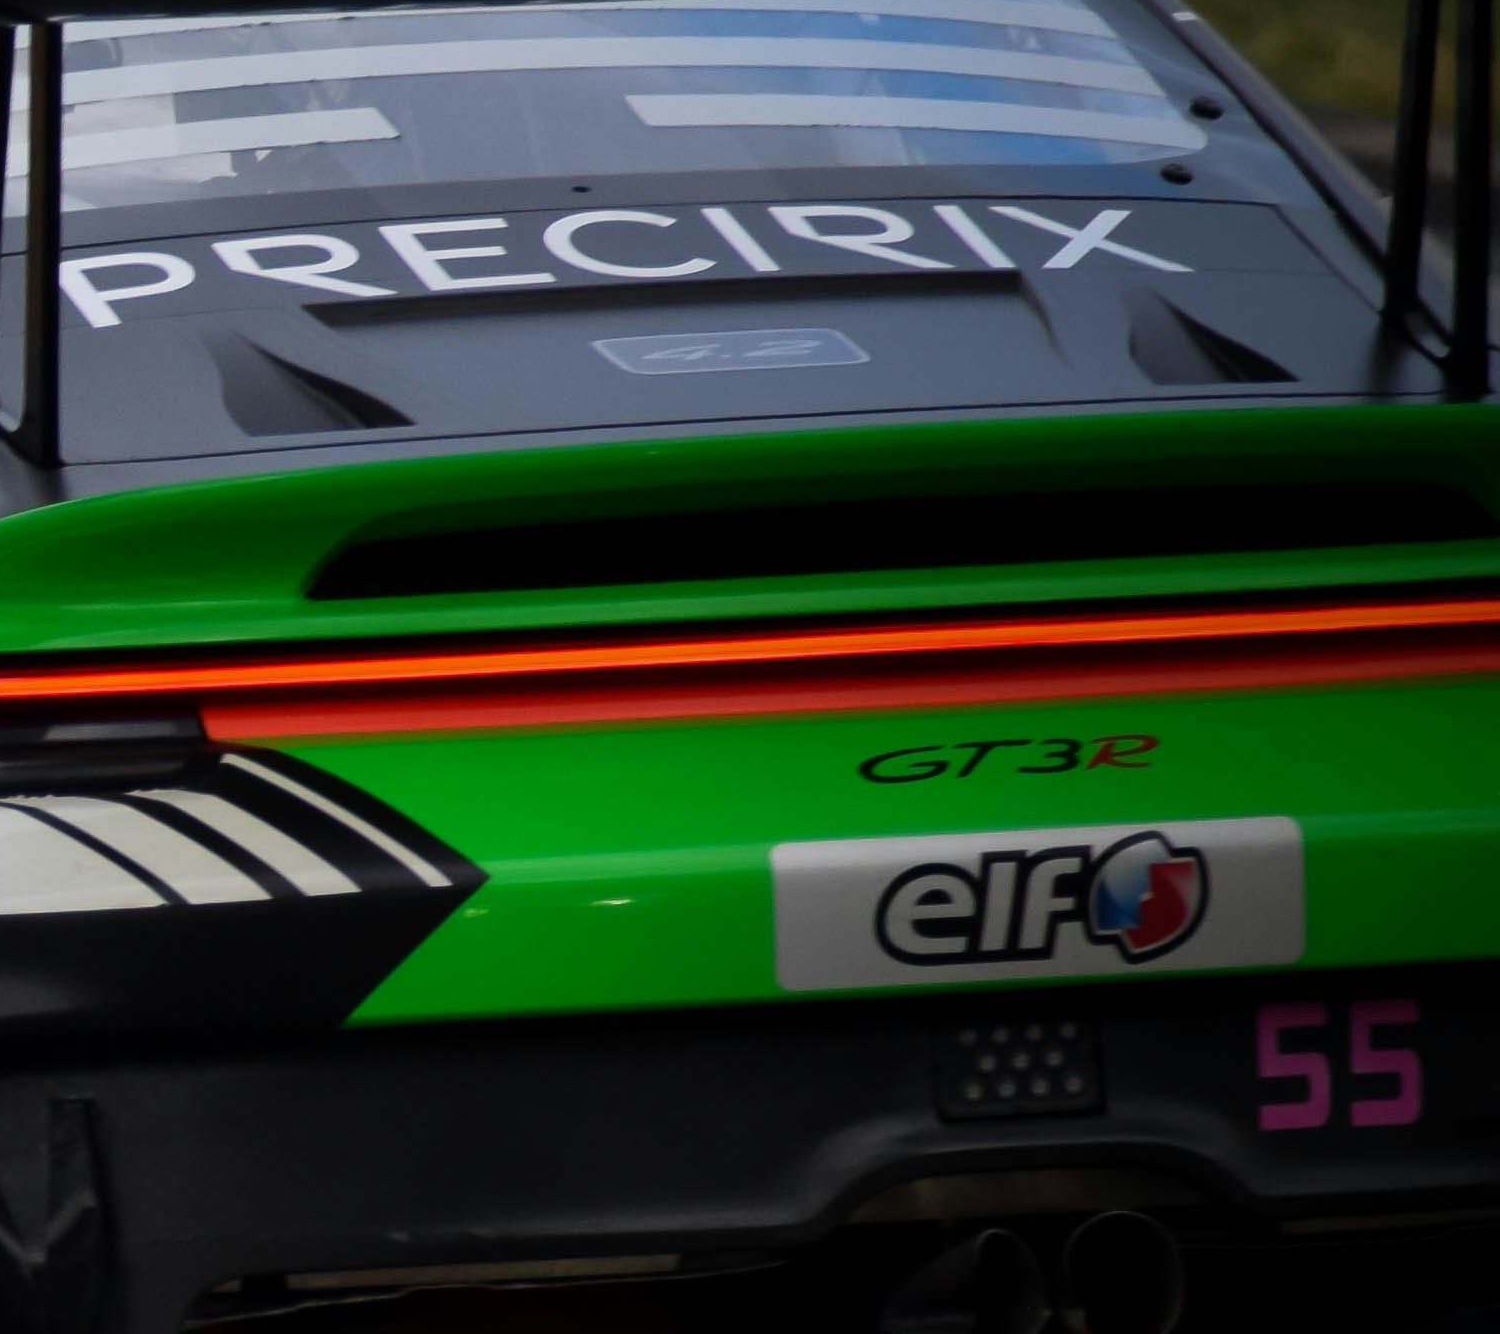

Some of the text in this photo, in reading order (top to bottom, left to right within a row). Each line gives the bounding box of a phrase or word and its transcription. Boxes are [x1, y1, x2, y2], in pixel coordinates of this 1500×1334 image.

[58, 204, 1197, 327] PRECIRIX
[875, 845, 1092, 967] elf
[1256, 998, 1423, 1131] 55
